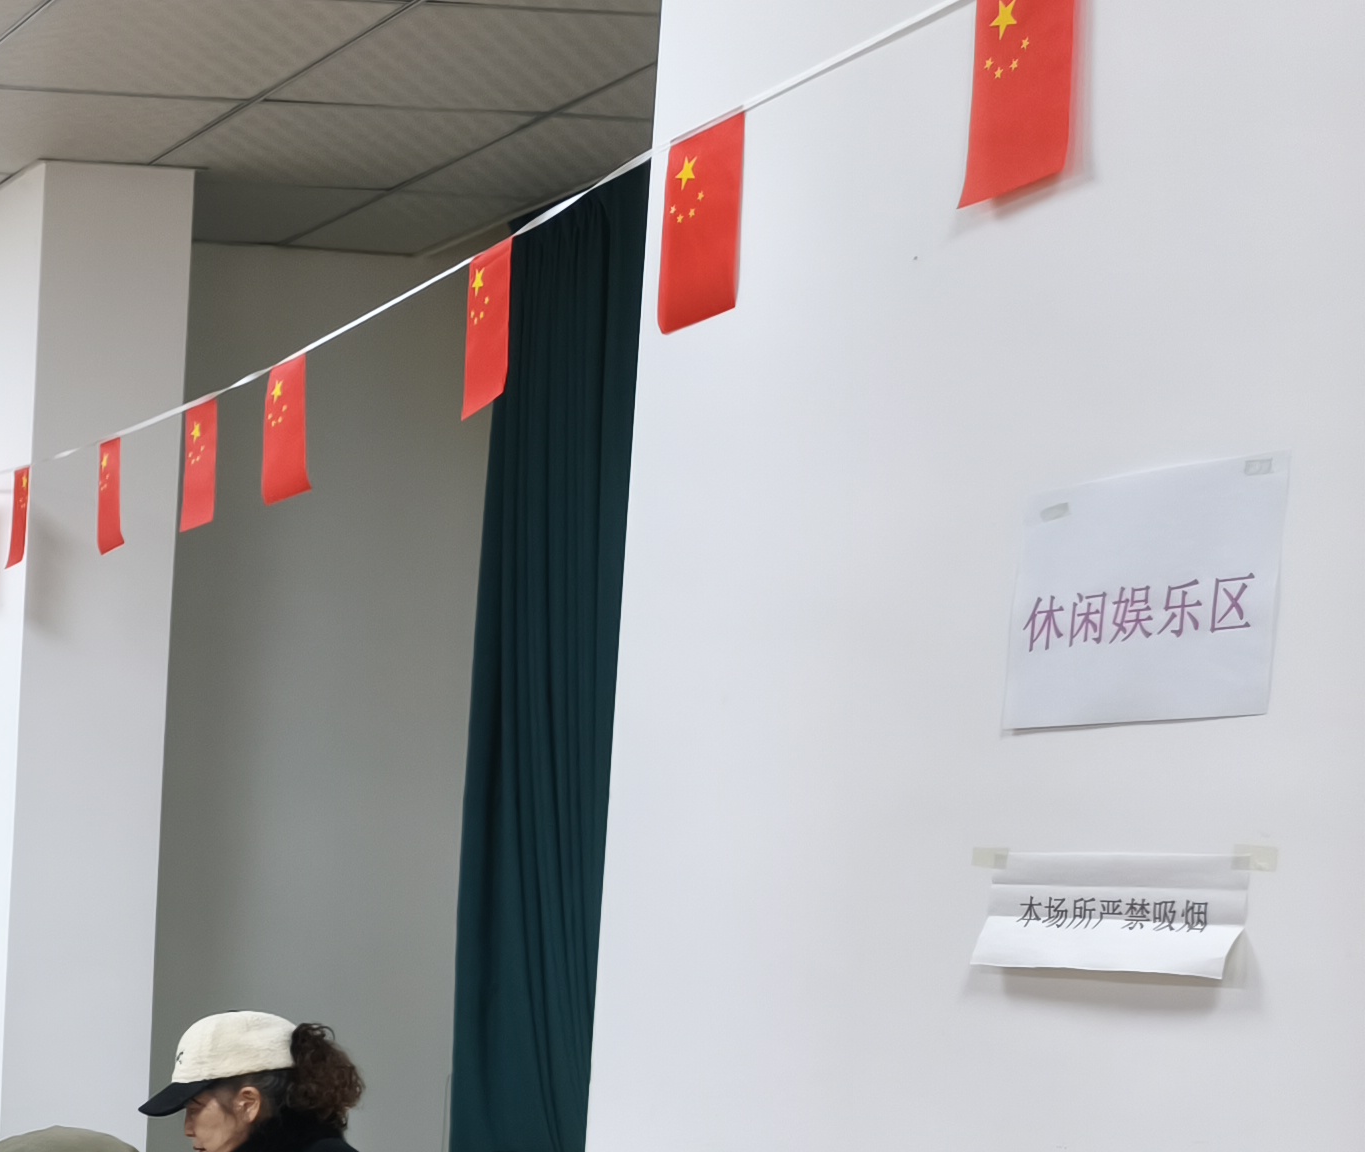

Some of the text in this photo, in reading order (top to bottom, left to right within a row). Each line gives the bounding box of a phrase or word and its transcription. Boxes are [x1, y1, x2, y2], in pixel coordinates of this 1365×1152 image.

[1022, 572, 1255, 652] 休闲娱乐区
[1015, 895, 1210, 934] 本场所严禁吸烟
